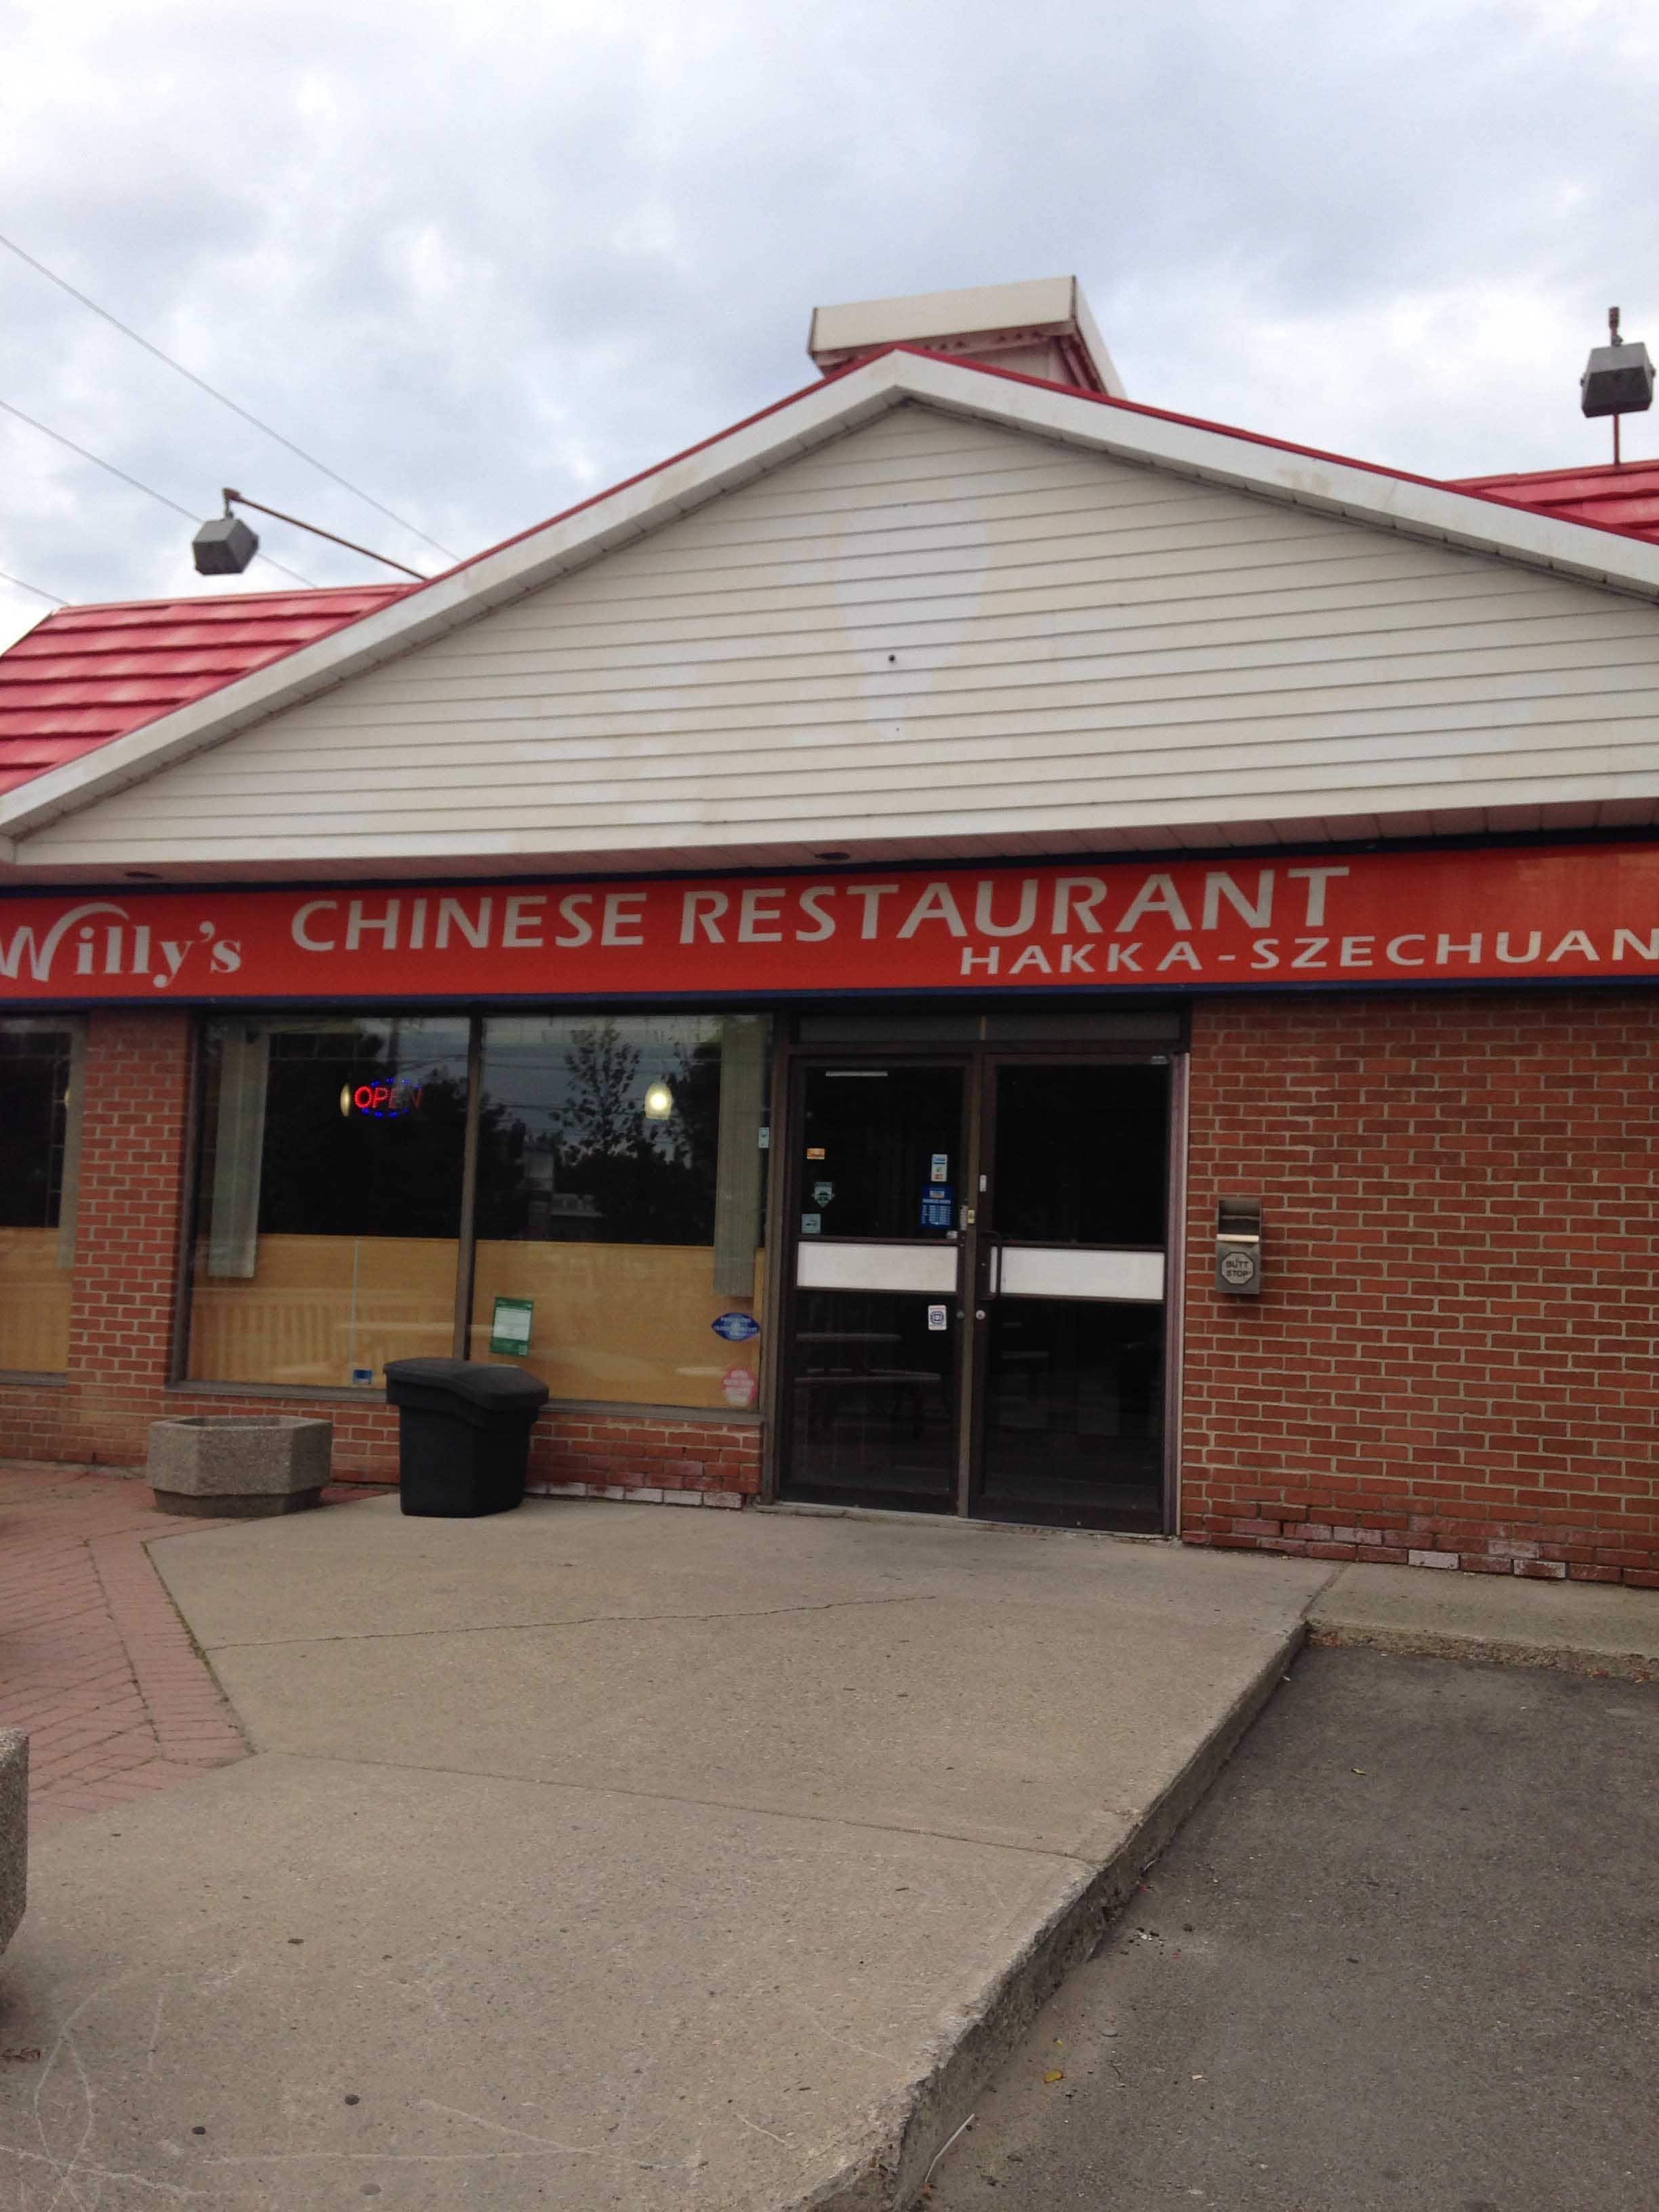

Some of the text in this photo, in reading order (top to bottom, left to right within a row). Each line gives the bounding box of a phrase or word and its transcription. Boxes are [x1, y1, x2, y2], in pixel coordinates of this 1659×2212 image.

[0, 865, 1351, 989] Willy's CHINESE RESTAURANT
[354, 1086, 424, 1109] OPEN
[1226, 1260, 1248, 1269] BUTT
[1226, 1269, 1248, 1278] STOP
